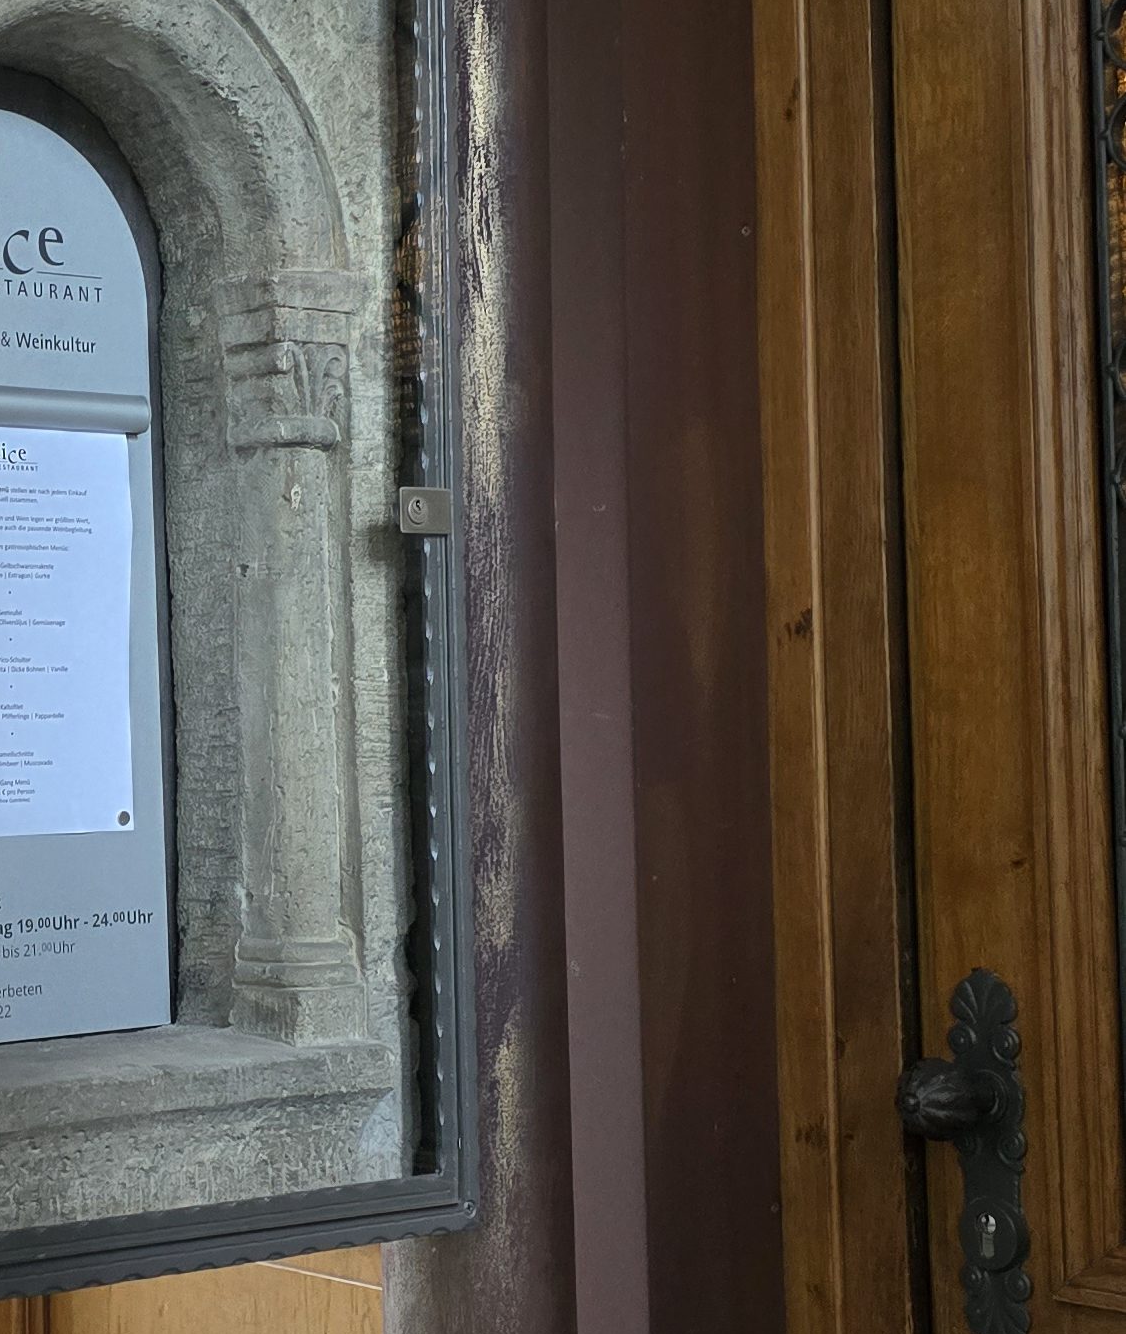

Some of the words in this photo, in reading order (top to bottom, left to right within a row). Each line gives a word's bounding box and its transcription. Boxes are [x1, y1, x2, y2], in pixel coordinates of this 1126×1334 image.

[1, 331, 11, 347] &
[16, 332, 96, 354] Weinkultur
[2, 945, 20, 959] bis
